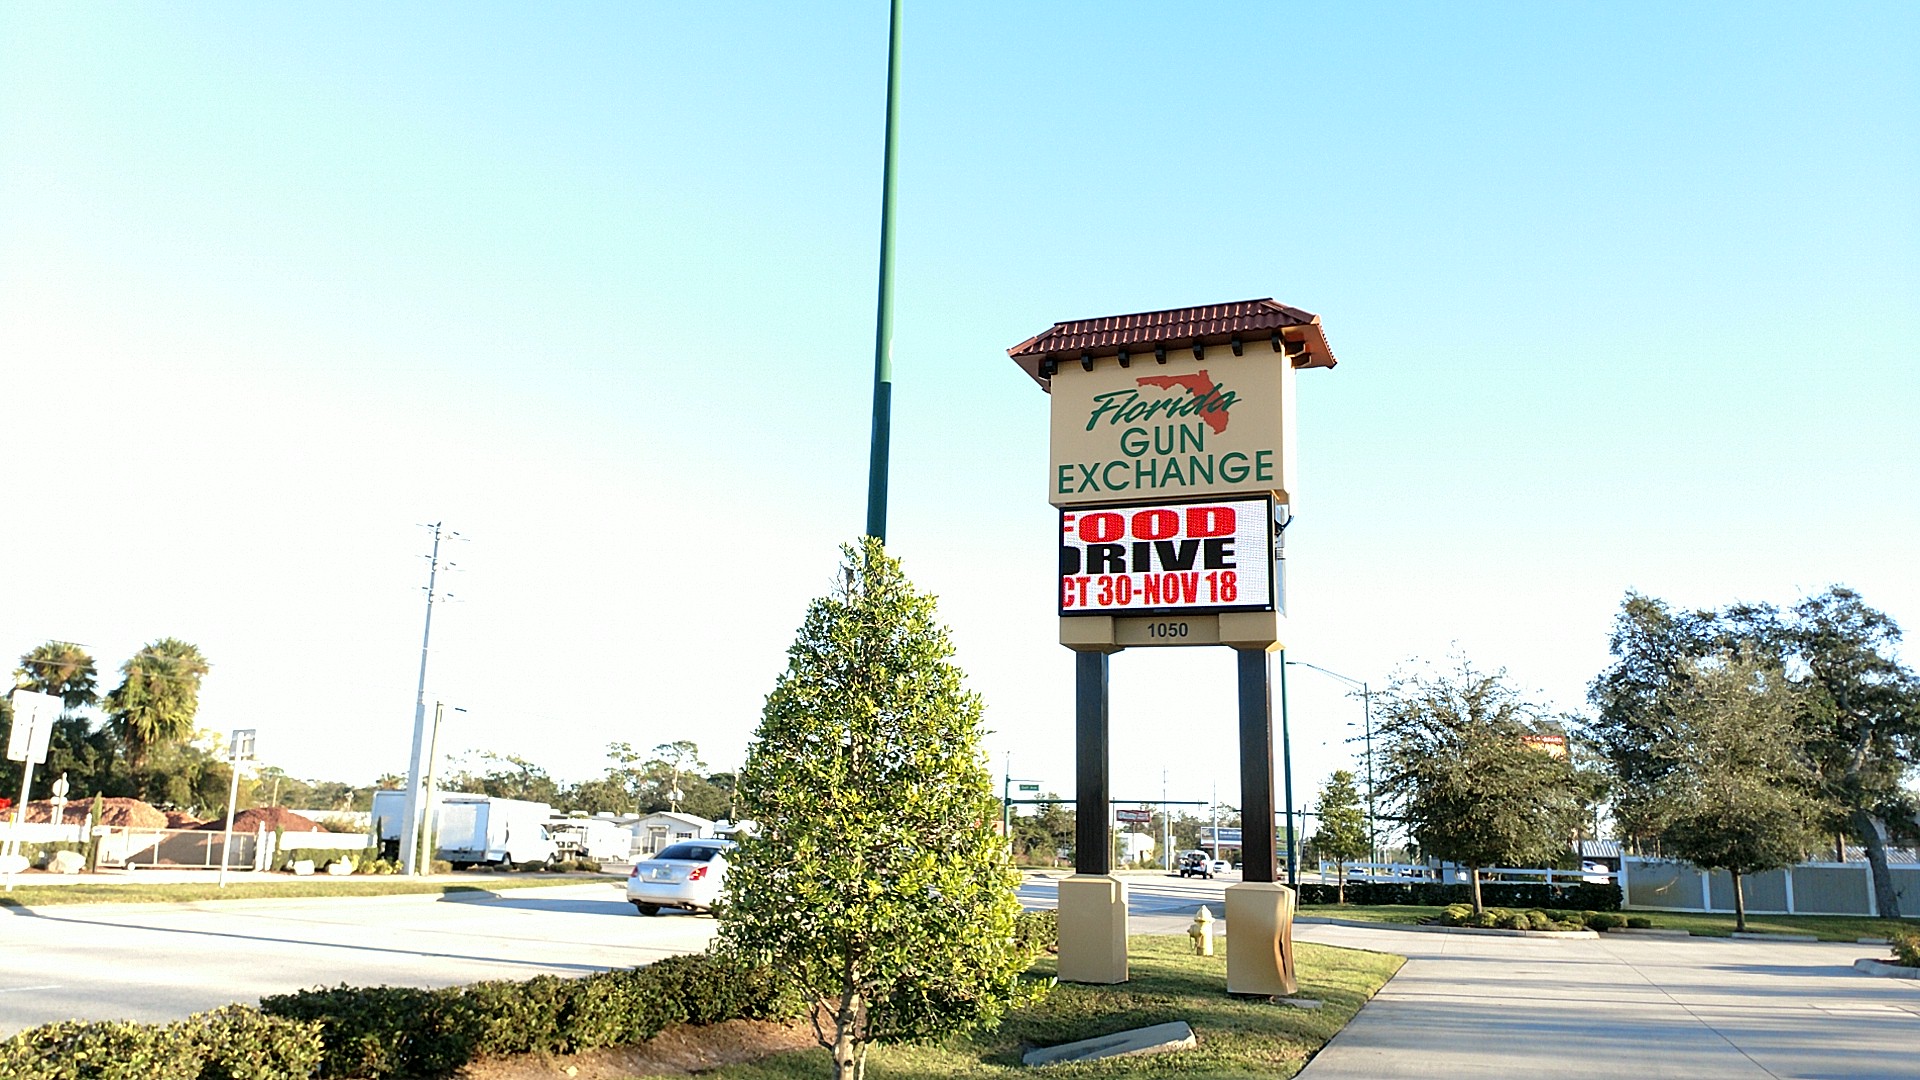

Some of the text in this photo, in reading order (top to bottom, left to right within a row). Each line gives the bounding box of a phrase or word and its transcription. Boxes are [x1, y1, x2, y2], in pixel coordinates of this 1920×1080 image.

[1086, 383, 1242, 431] Florida
[1120, 422, 1204, 457] GUN
[1058, 450, 1273, 494] EXCHANGE
[1097, 572, 1199, 606] 30-NOV
[1204, 571, 1237, 603] 18
[1147, 623, 1189, 638] 1050
